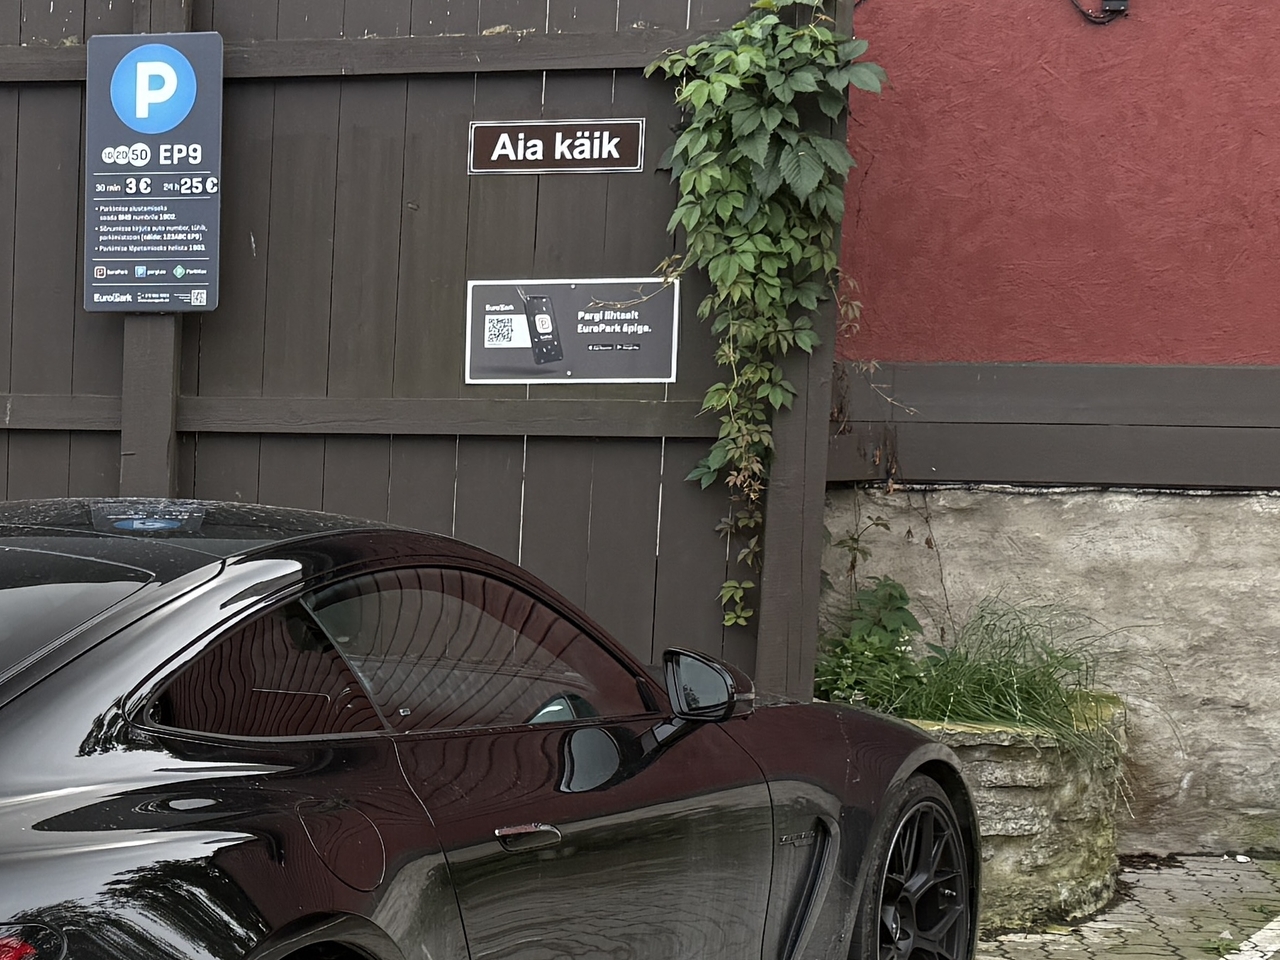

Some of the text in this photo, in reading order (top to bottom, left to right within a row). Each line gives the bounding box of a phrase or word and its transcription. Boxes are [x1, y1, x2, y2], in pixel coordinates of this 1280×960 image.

[136, 61, 178, 118] P
[490, 131, 620, 160] Aia käik
[131, 149, 148, 160] 50
[160, 144, 202, 165] EP9
[96, 184, 106, 192] 30
[106, 184, 121, 192] min
[578, 310, 603, 322] Pargi
[577, 323, 621, 333] EuroPark
